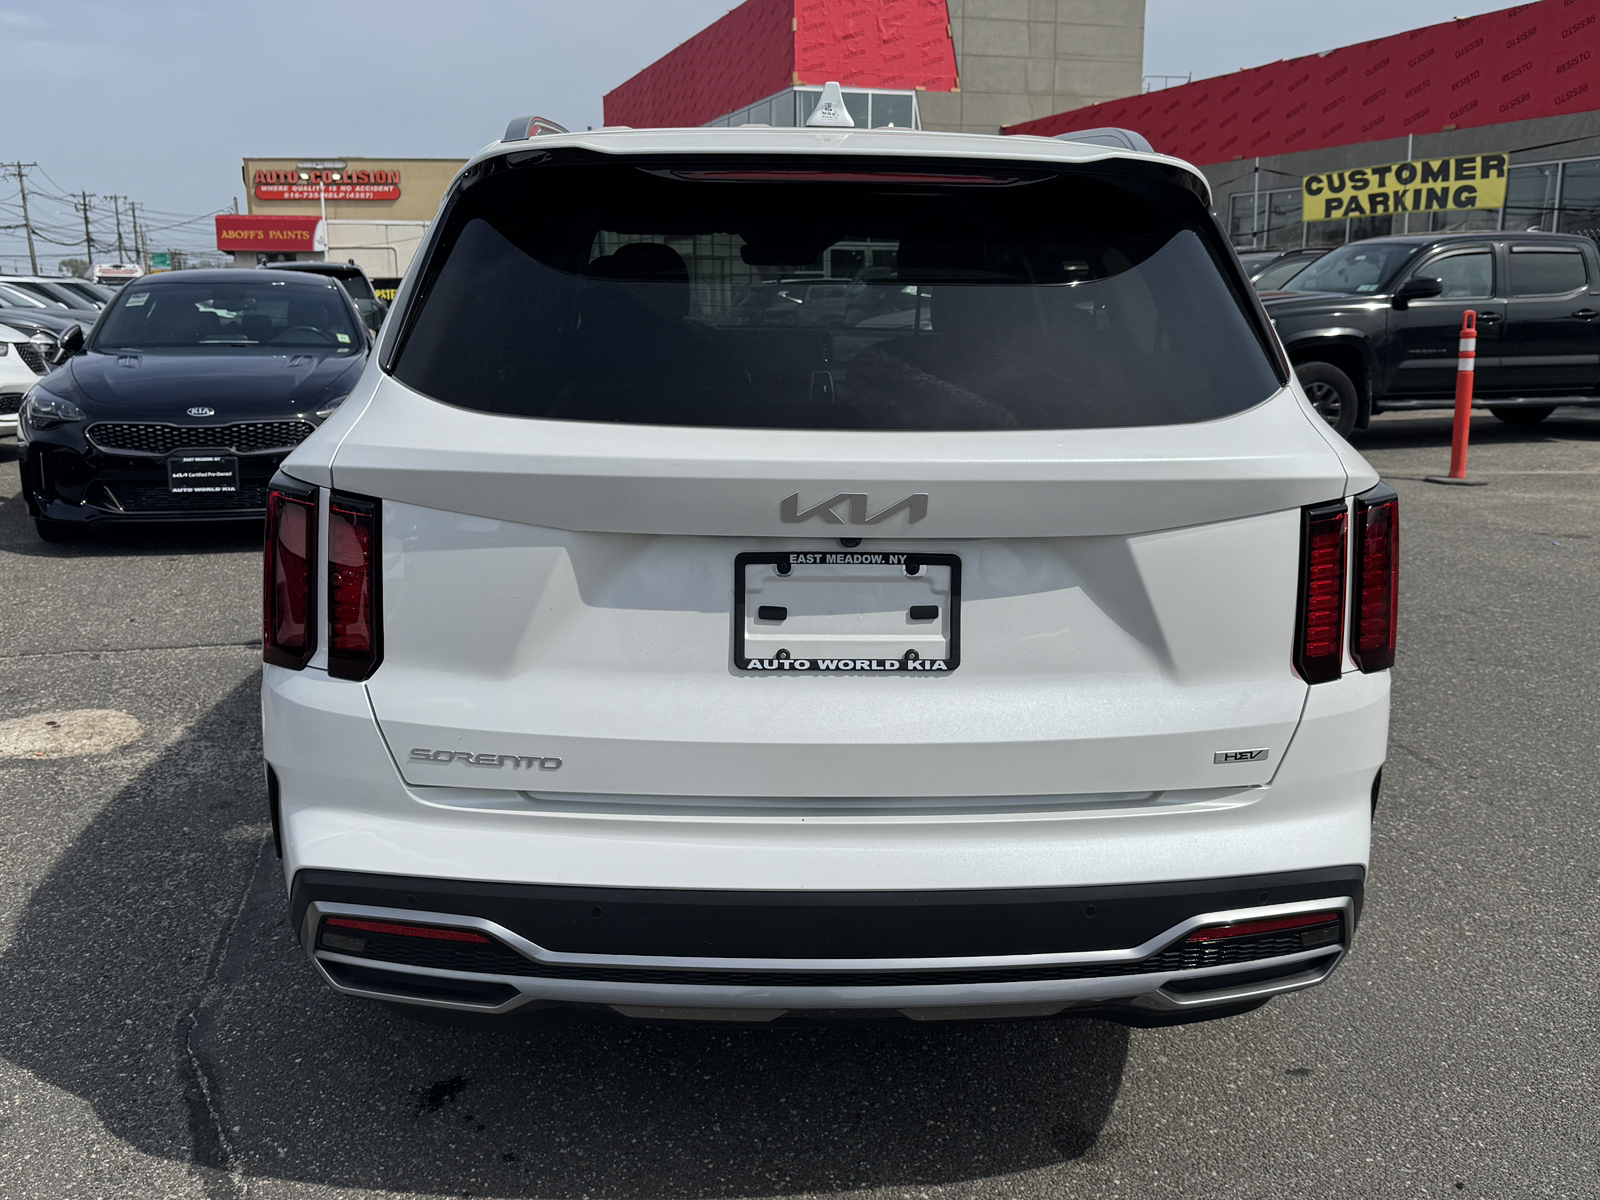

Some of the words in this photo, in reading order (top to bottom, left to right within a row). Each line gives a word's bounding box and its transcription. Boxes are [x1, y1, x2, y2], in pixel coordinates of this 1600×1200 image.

[1561, 14, 1596, 38] RESISTO
[1454, 37, 1484, 59] RESISTO
[1505, 26, 1537, 49] RESISTO
[1501, 61, 1533, 83] RESISTO
[1556, 51, 1590, 75] RESISTO
[1451, 69, 1480, 91] RESISTO
[1499, 92, 1530, 113] RESISTO
[1554, 82, 1588, 106] RESISTO
[1449, 99, 1478, 120] RESISTO
[254, 170, 299, 184] AUTO
[1304, 154, 1506, 196] CUSTOMER
[1324, 185, 1477, 219] PARKING
[221, 230, 264, 239] ABOFF'S
[269, 230, 310, 239] PAINTS
[780, 491, 929, 525] KIA
[790, 554, 822, 564] EAST
[889, 555, 907, 564] NY
[747, 660, 811, 670] AUTO
[818, 660, 900, 670] WORLD
[907, 660, 948, 670] KIA
[409, 748, 562, 768] SORENTO
[1224, 750, 1263, 761] HEV
